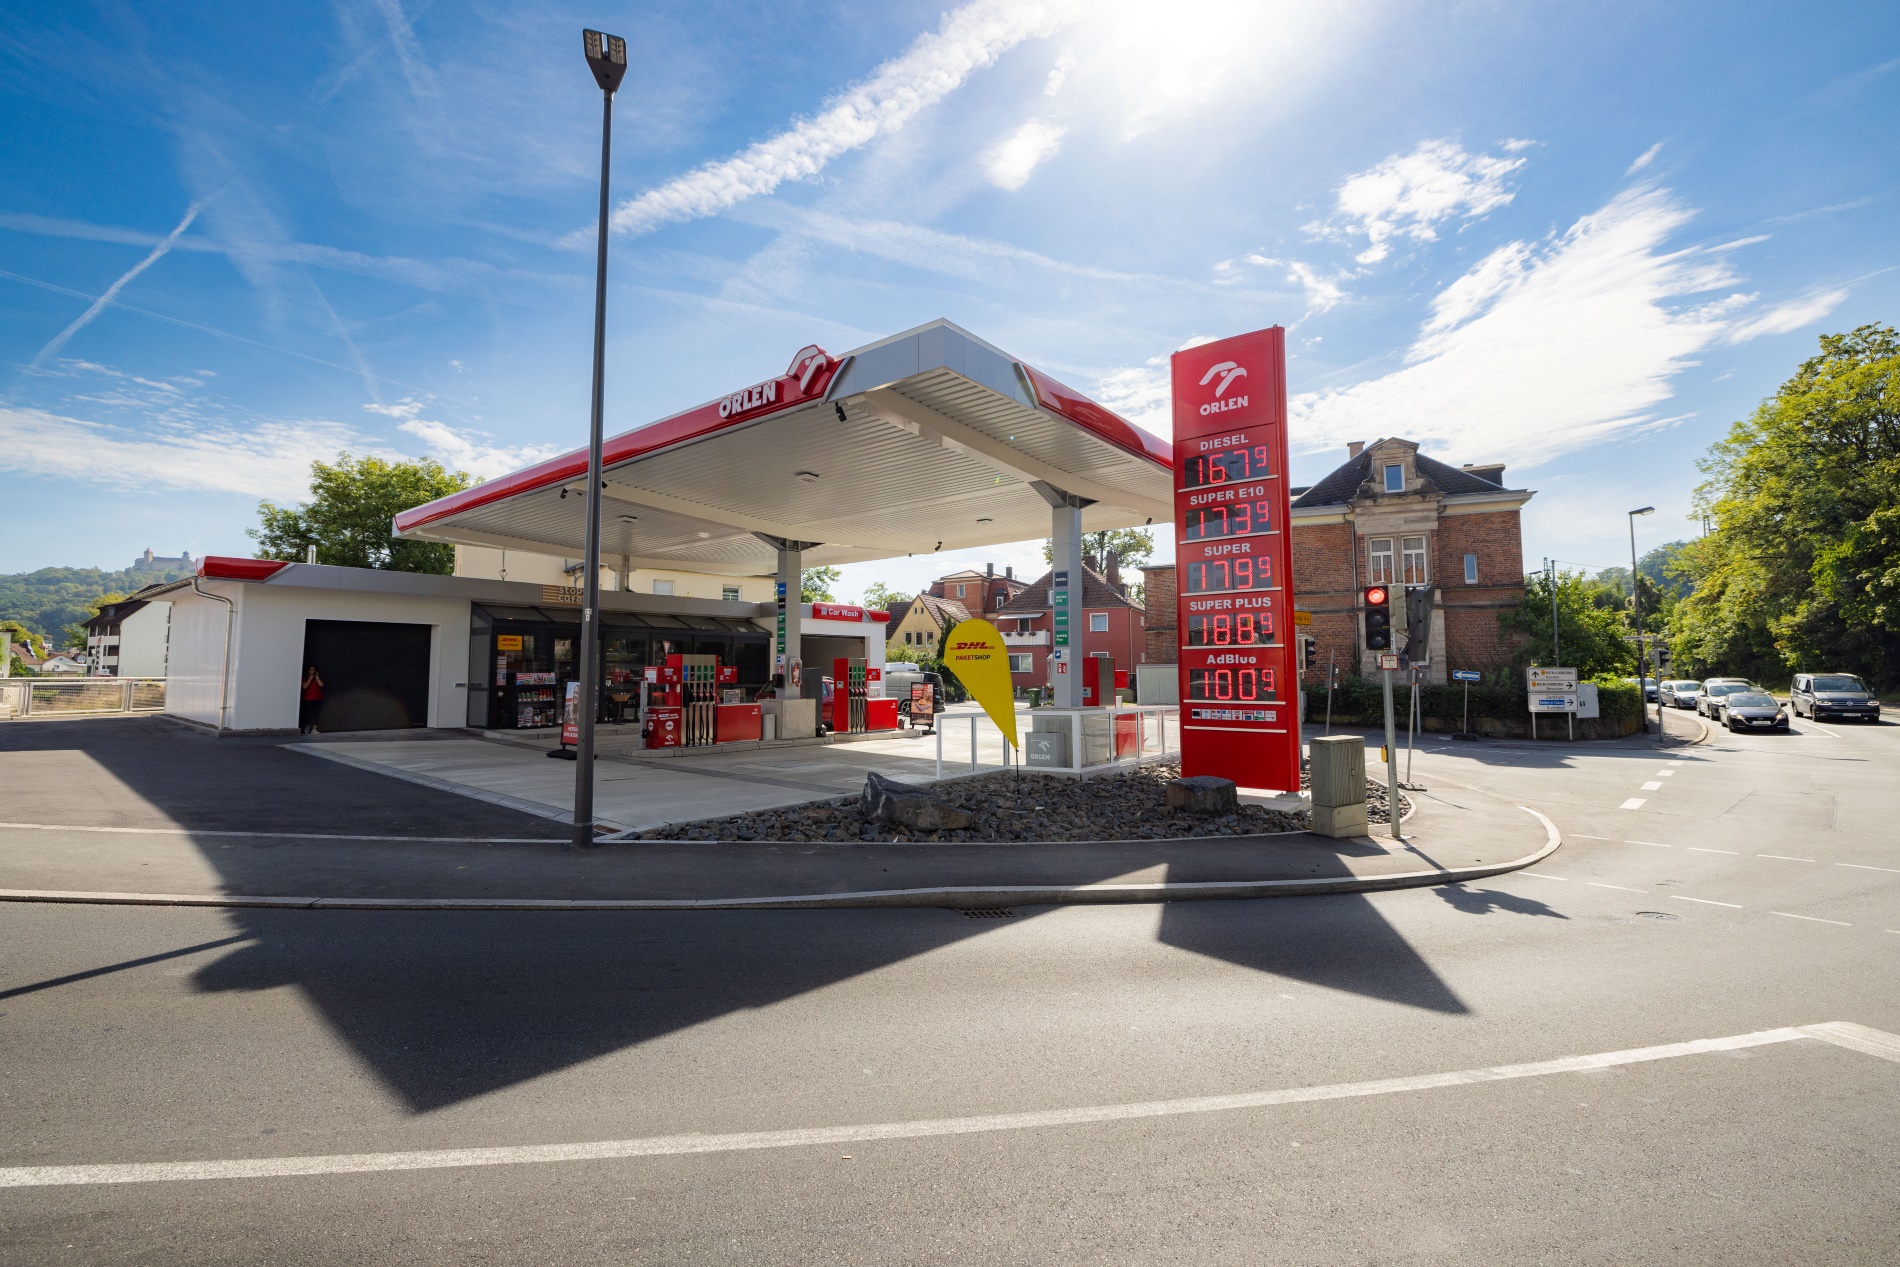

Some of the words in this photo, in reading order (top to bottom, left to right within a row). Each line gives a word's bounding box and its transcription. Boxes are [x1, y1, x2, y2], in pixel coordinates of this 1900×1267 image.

[719, 381, 776, 418] ORLEN
[1200, 396, 1248, 416] ORLEN
[1200, 434, 1248, 451] DIESEL
[1190, 489, 1234, 505] SUPER
[1239, 486, 1264, 499] E10
[1204, 543, 1251, 556] SUPER
[559, 587, 583, 596] stop
[1190, 600, 1232, 611] SUPER
[1236, 597, 1271, 608] PLUS
[828, 608, 841, 616] Car
[841, 609, 859, 617] Wash
[956, 642, 988, 650] DHL
[1206, 654, 1257, 664] AdBlue
